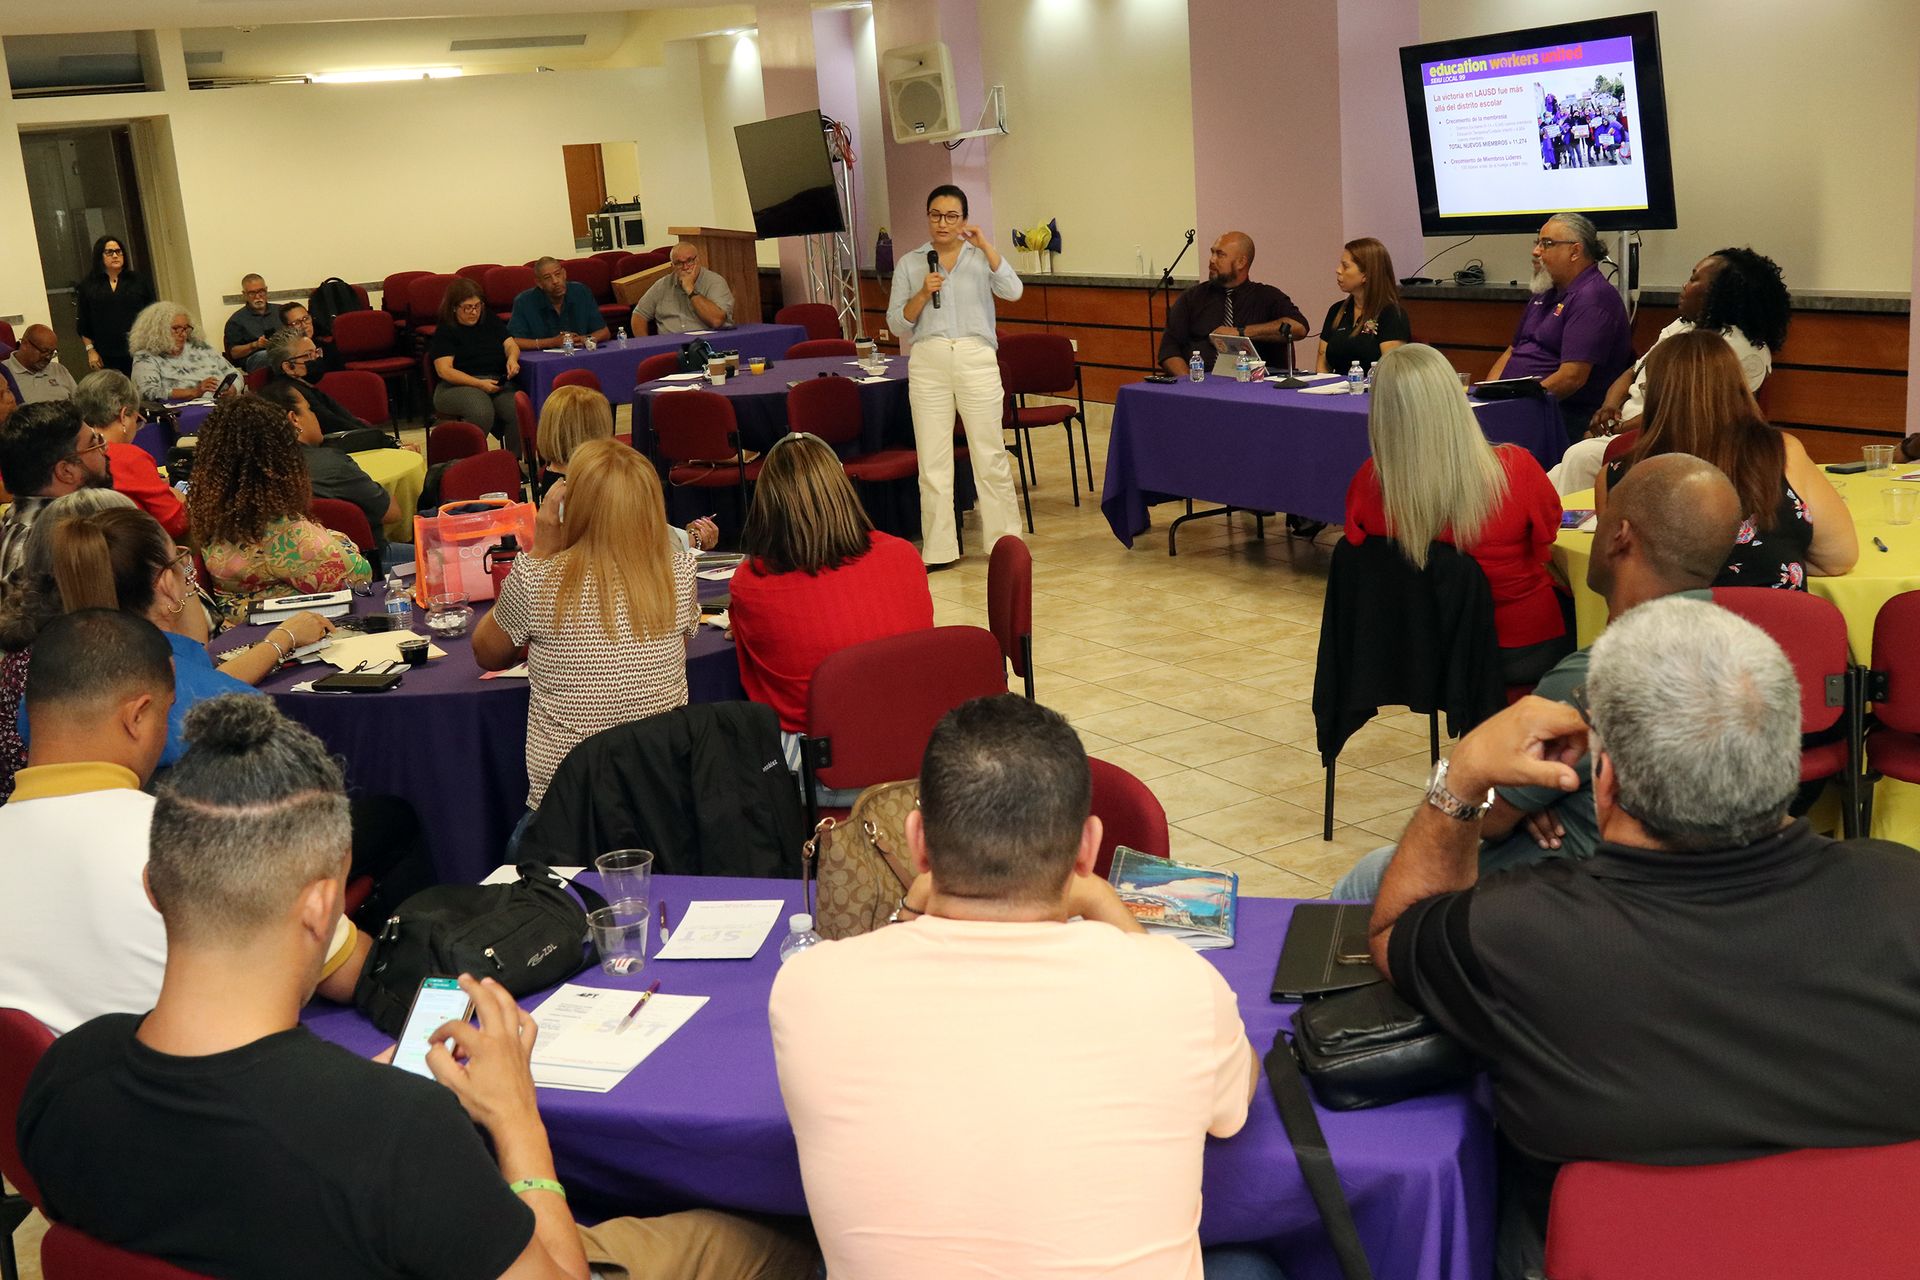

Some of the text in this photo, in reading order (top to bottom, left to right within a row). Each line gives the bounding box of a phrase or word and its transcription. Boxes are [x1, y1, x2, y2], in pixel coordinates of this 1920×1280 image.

[1429, 45, 1583, 77] education workers united
[1430, 76, 1442, 84] SEIU
[1443, 75, 1458, 83] LOCAL
[1442, 92, 1464, 101] victoria
[1474, 87, 1497, 97] LAUSD
[1498, 87, 1508, 95] fue
[1446, 103, 1456, 111] del
[1457, 101, 1479, 111] distrito
[1479, 99, 1502, 107] escolar
